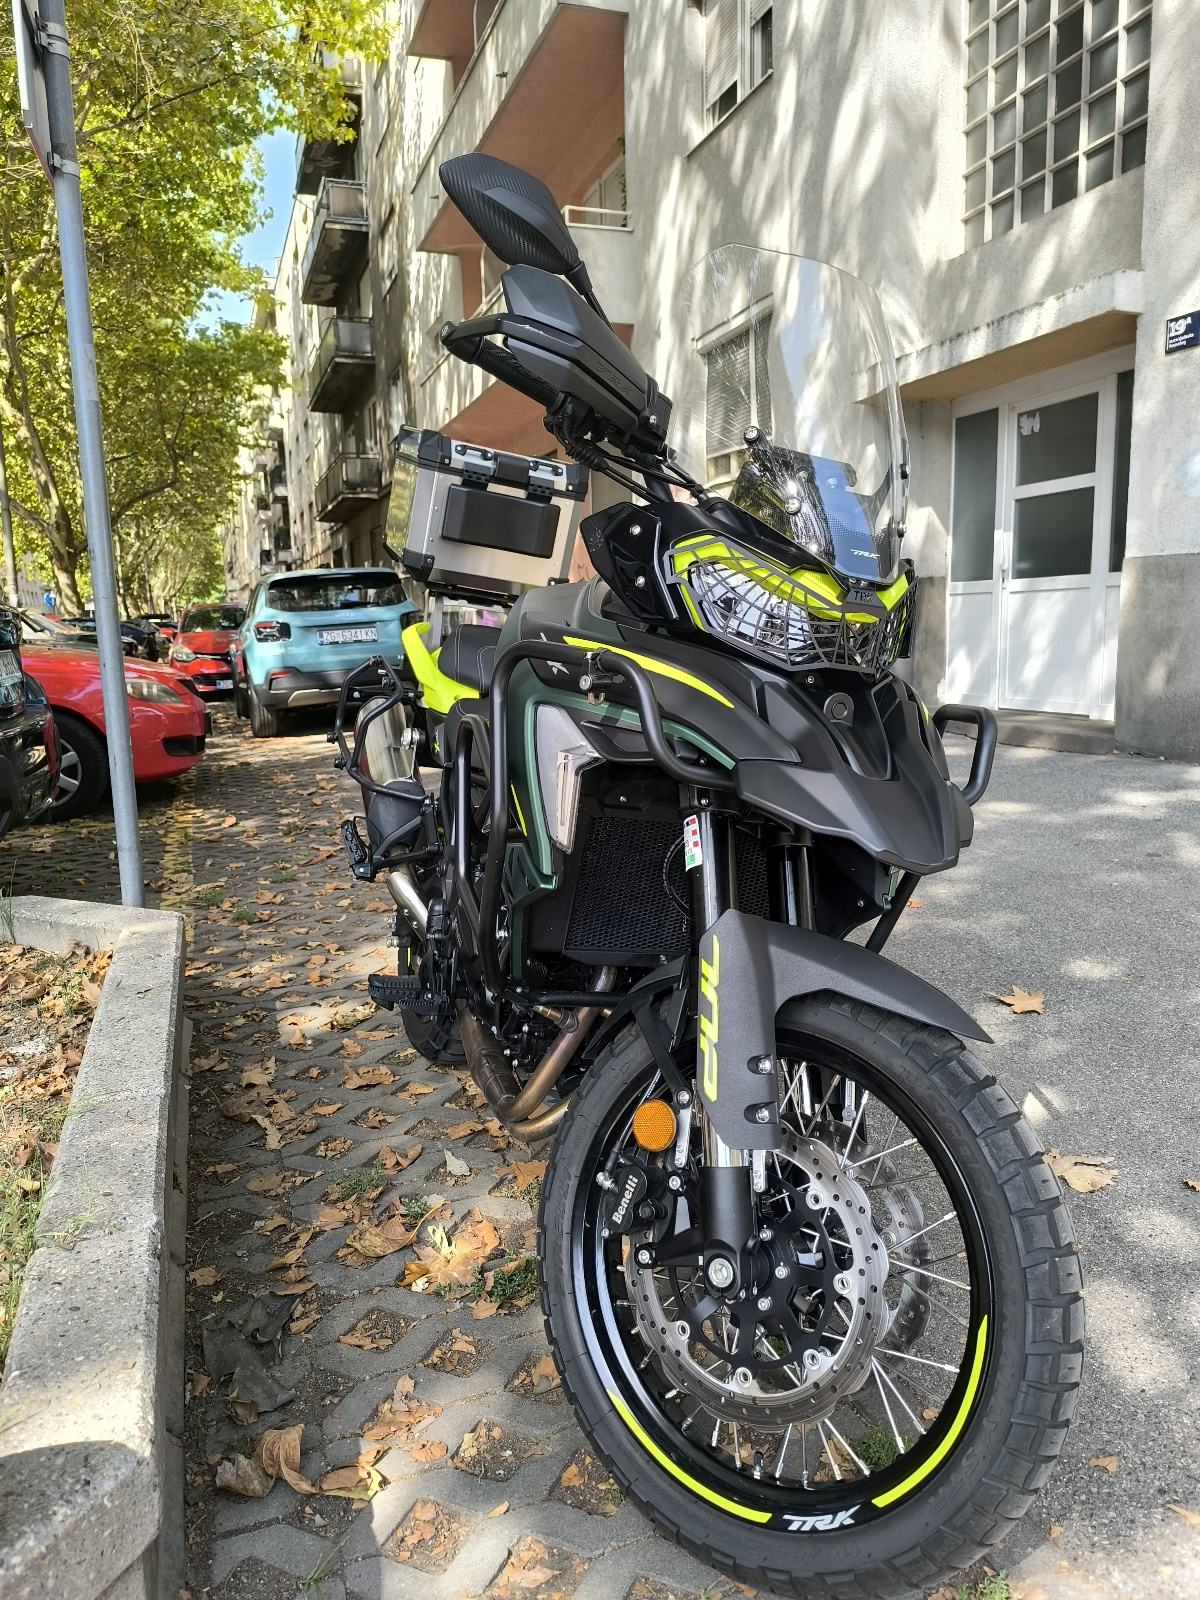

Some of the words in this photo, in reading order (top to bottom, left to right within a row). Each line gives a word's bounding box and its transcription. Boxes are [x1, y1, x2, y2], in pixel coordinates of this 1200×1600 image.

[850, 549, 880, 559] TRK
[853, 590, 874, 603] TRK
[325, 631, 336, 641] ZG
[612, 1174, 639, 1225] Benelli
[782, 1504, 861, 1531] TRK
